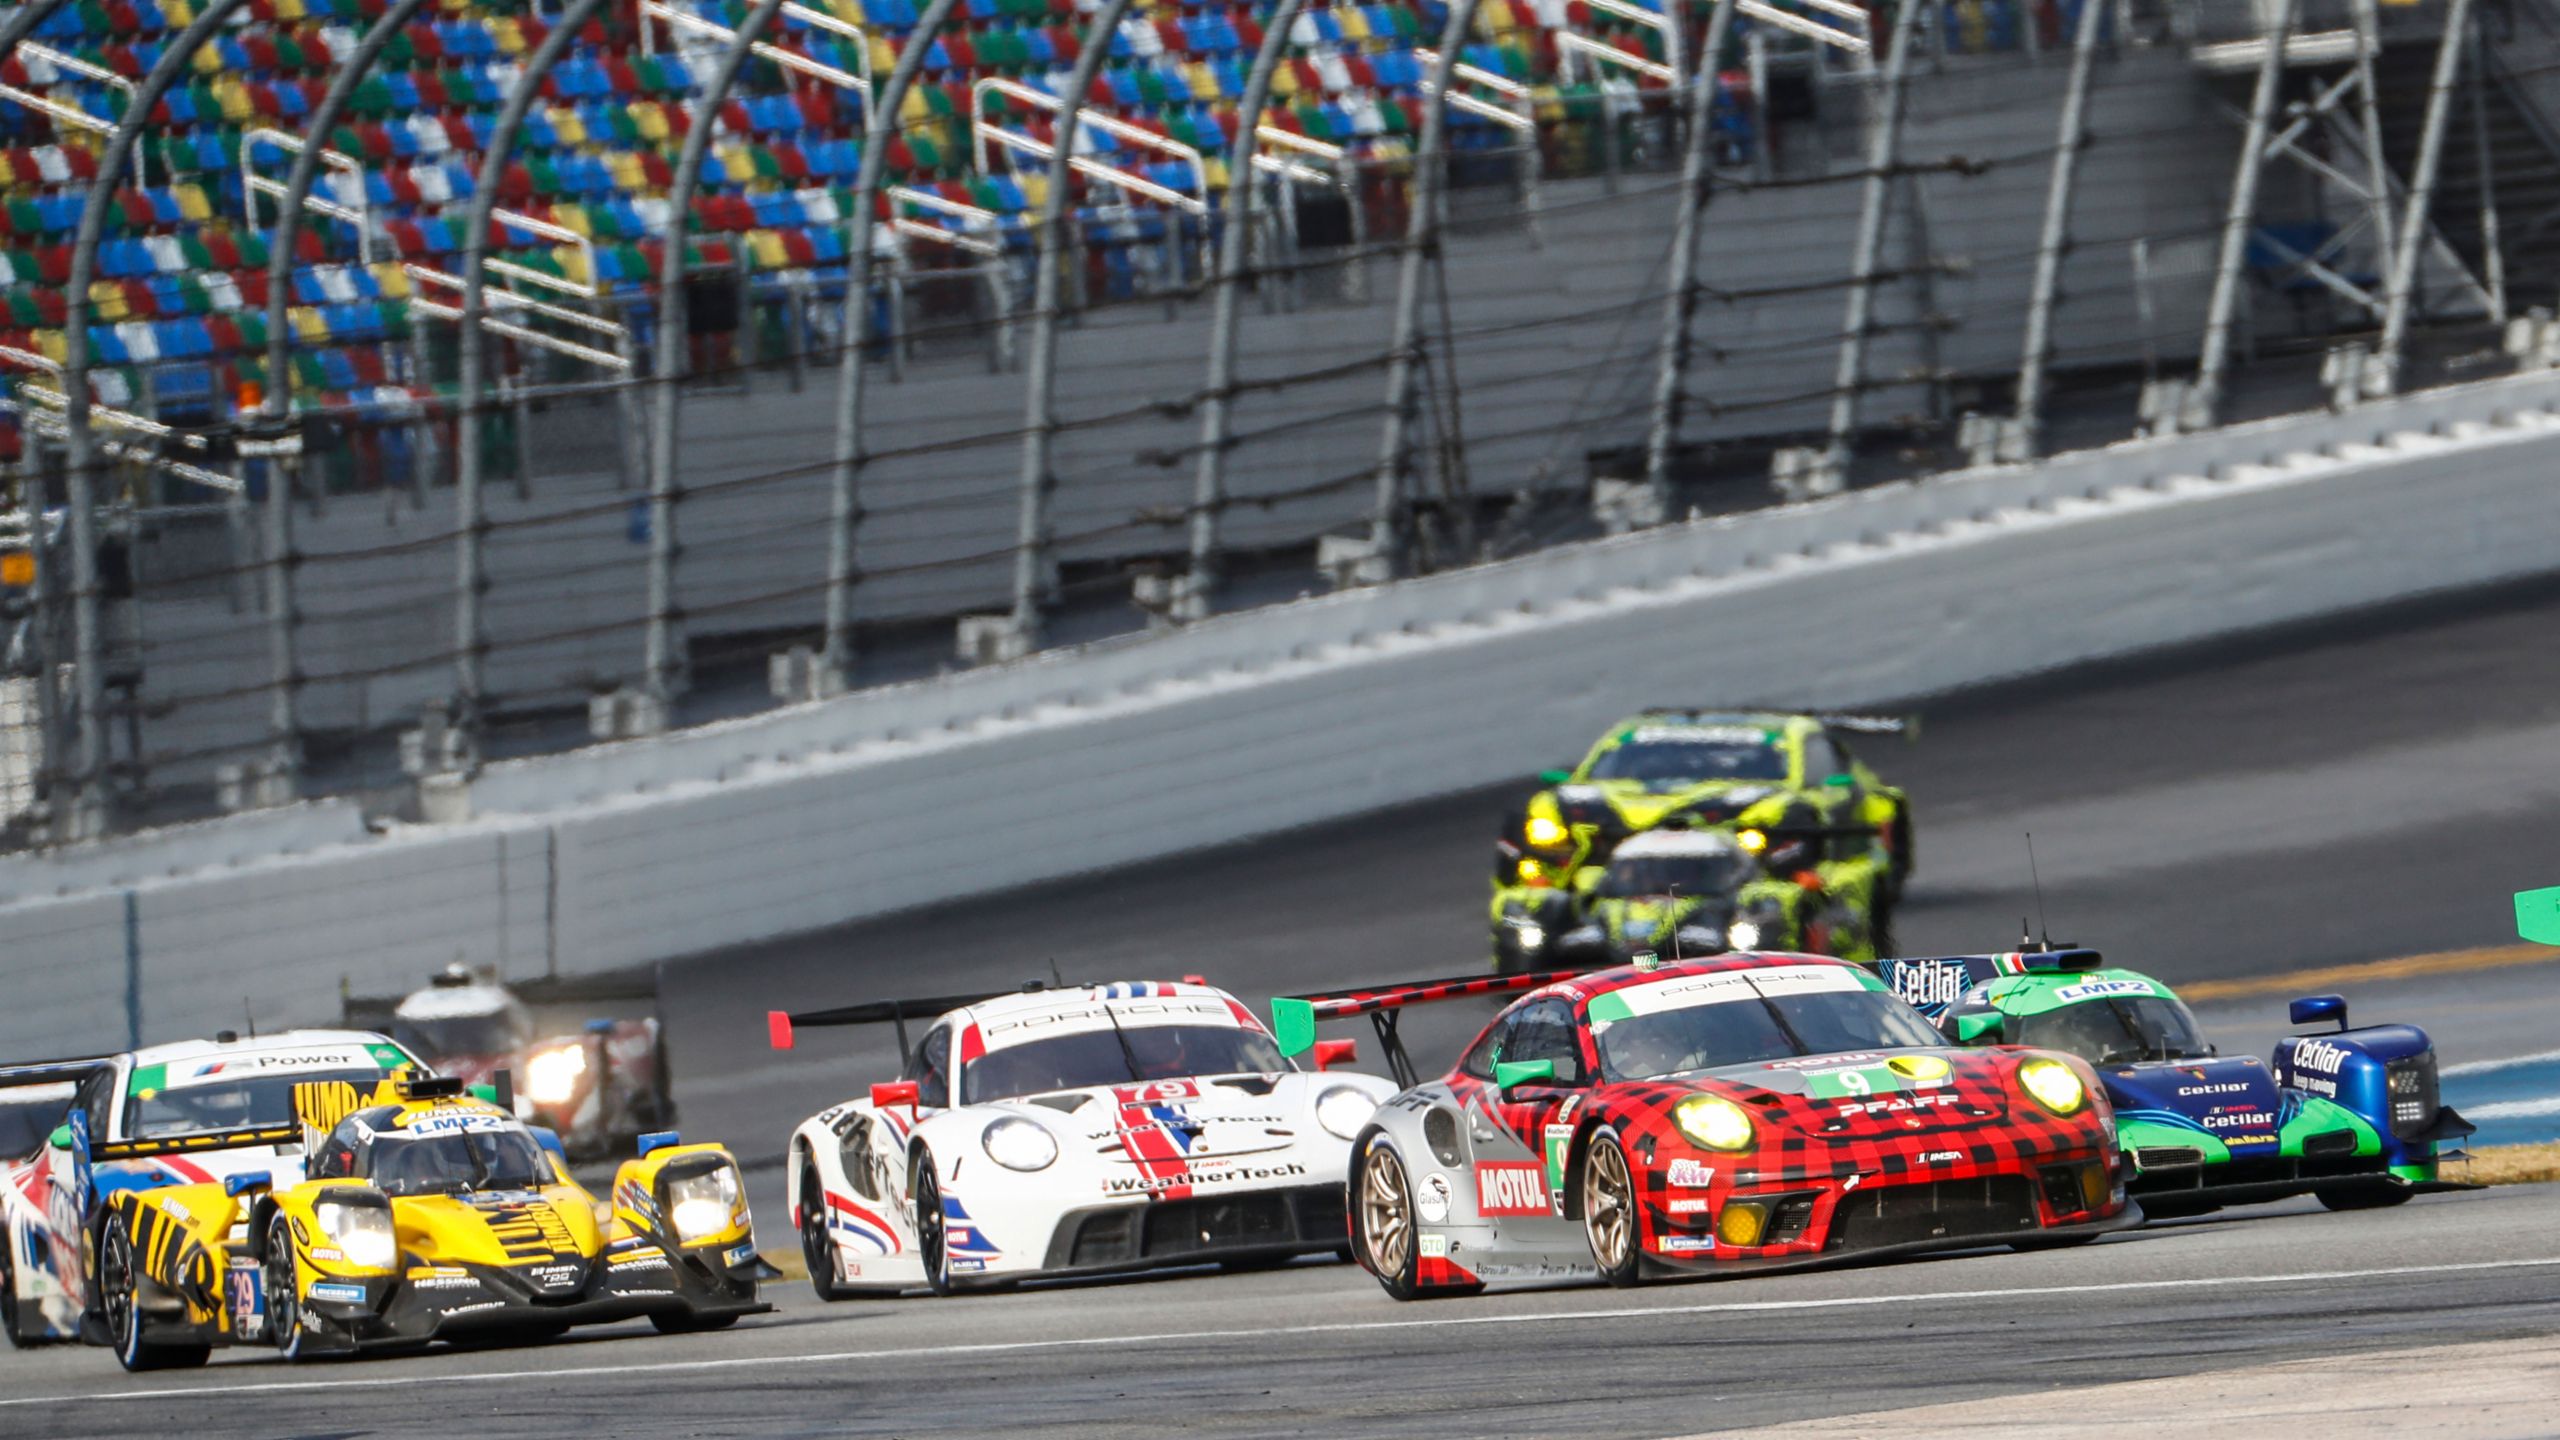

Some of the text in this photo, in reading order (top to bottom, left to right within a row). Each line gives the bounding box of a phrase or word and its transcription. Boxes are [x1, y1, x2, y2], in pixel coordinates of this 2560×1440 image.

[1661, 974, 1824, 996] PORSCHE
[1893, 959, 1963, 1005] Cetilar
[2061, 981, 2150, 1000] LMP2
[987, 1005, 1229, 1036] PORSCHE
[258, 1056, 352, 1067] Power
[1772, 1053, 1887, 1069] MOTUL
[2294, 1038, 2352, 1074] Cetilar
[1121, 1081, 1187, 1101] 79
[1838, 1071, 1871, 1097] 9
[2178, 1082, 2250, 1096] Cetilar
[1838, 1094, 1959, 1118] PFAFF
[414, 1116, 499, 1134] LMP2
[2203, 1112, 2274, 1128] Cetilar
[1929, 1150, 1963, 1161] IMSA
[1109, 1163, 1306, 1191] WeatherTech
[1480, 1168, 1547, 1209] MOTUL
[1670, 1199, 1706, 1212] MOTUL
[1421, 1239, 1444, 1252] GTD
[233, 1271, 255, 1314] 29
